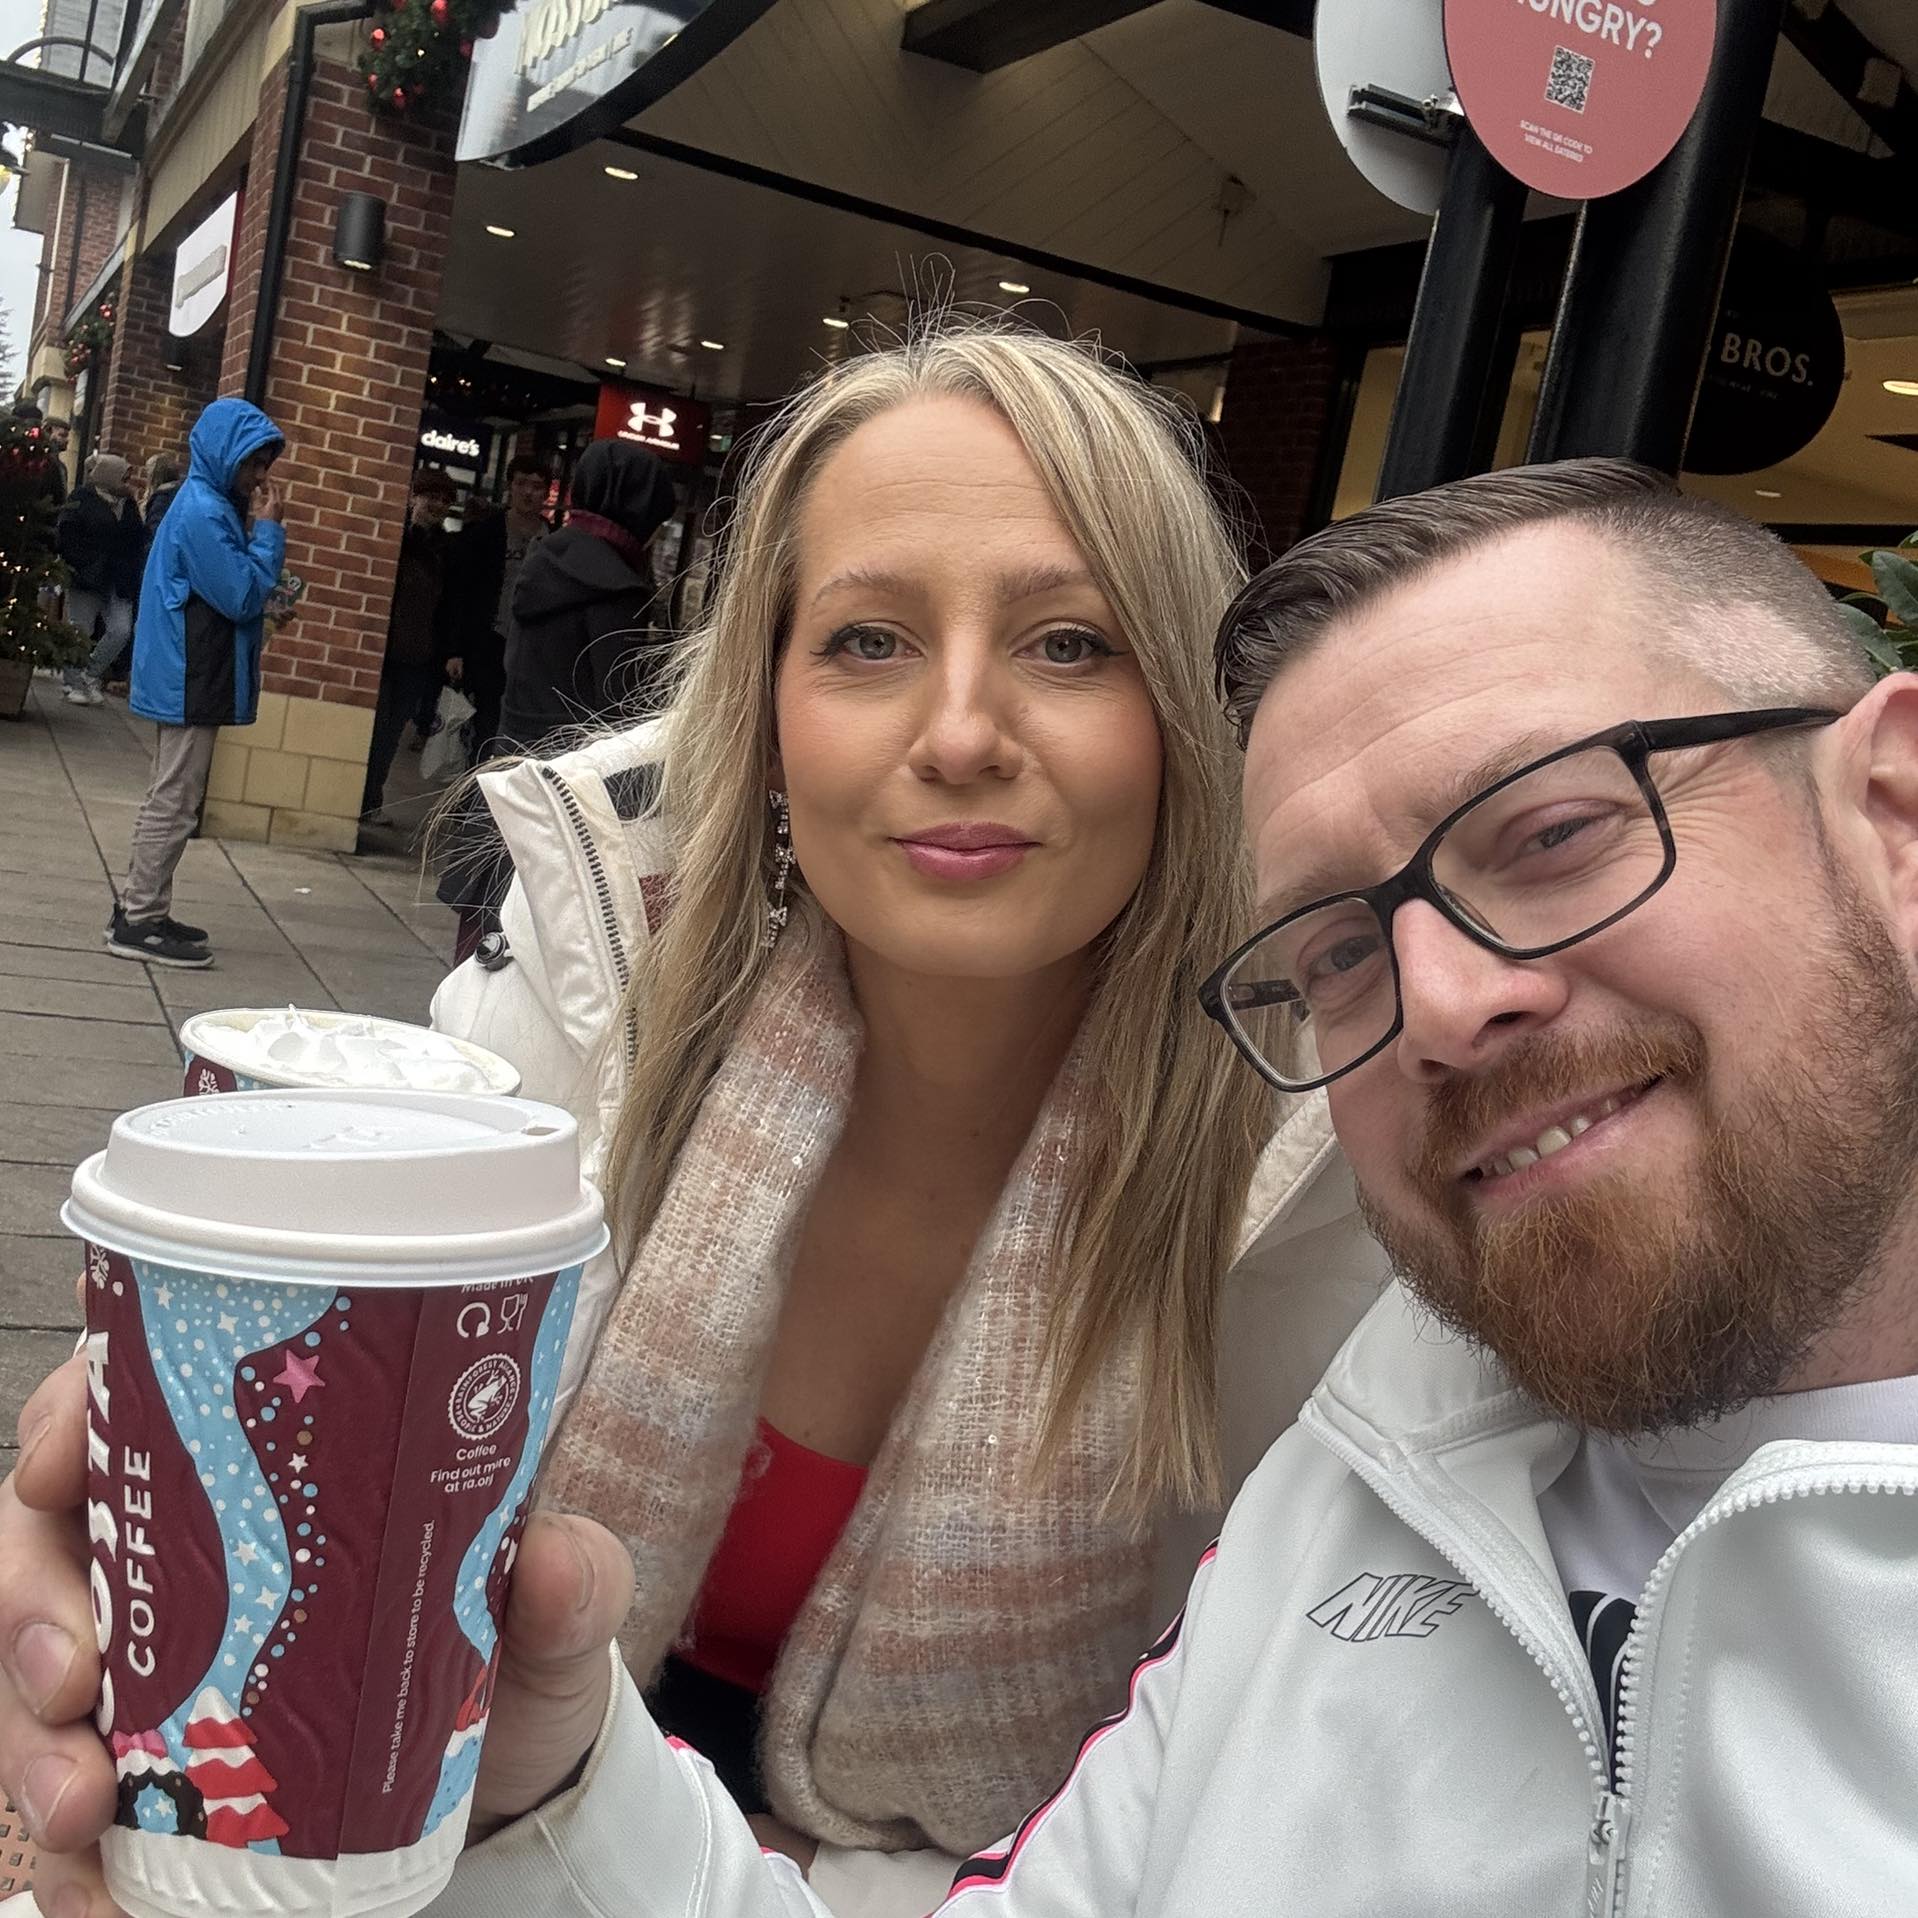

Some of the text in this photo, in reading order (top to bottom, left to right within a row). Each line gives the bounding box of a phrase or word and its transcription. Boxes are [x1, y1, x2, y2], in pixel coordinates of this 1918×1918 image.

[1517, 0, 1662, 58] NGRY?
[1720, 332, 1813, 386] BROS.
[421, 429, 480, 457] claire's
[430, 1467, 460, 1483] Find
[461, 1464, 481, 1479] out
[456, 1444, 497, 1461] Coffee
[444, 1480, 460, 1493] at
[123, 1445, 155, 1677] COFFEE
[1306, 1572, 1481, 1643] NIKE
[382, 1519, 435, 1794] Please take me back to store to be recycled.
